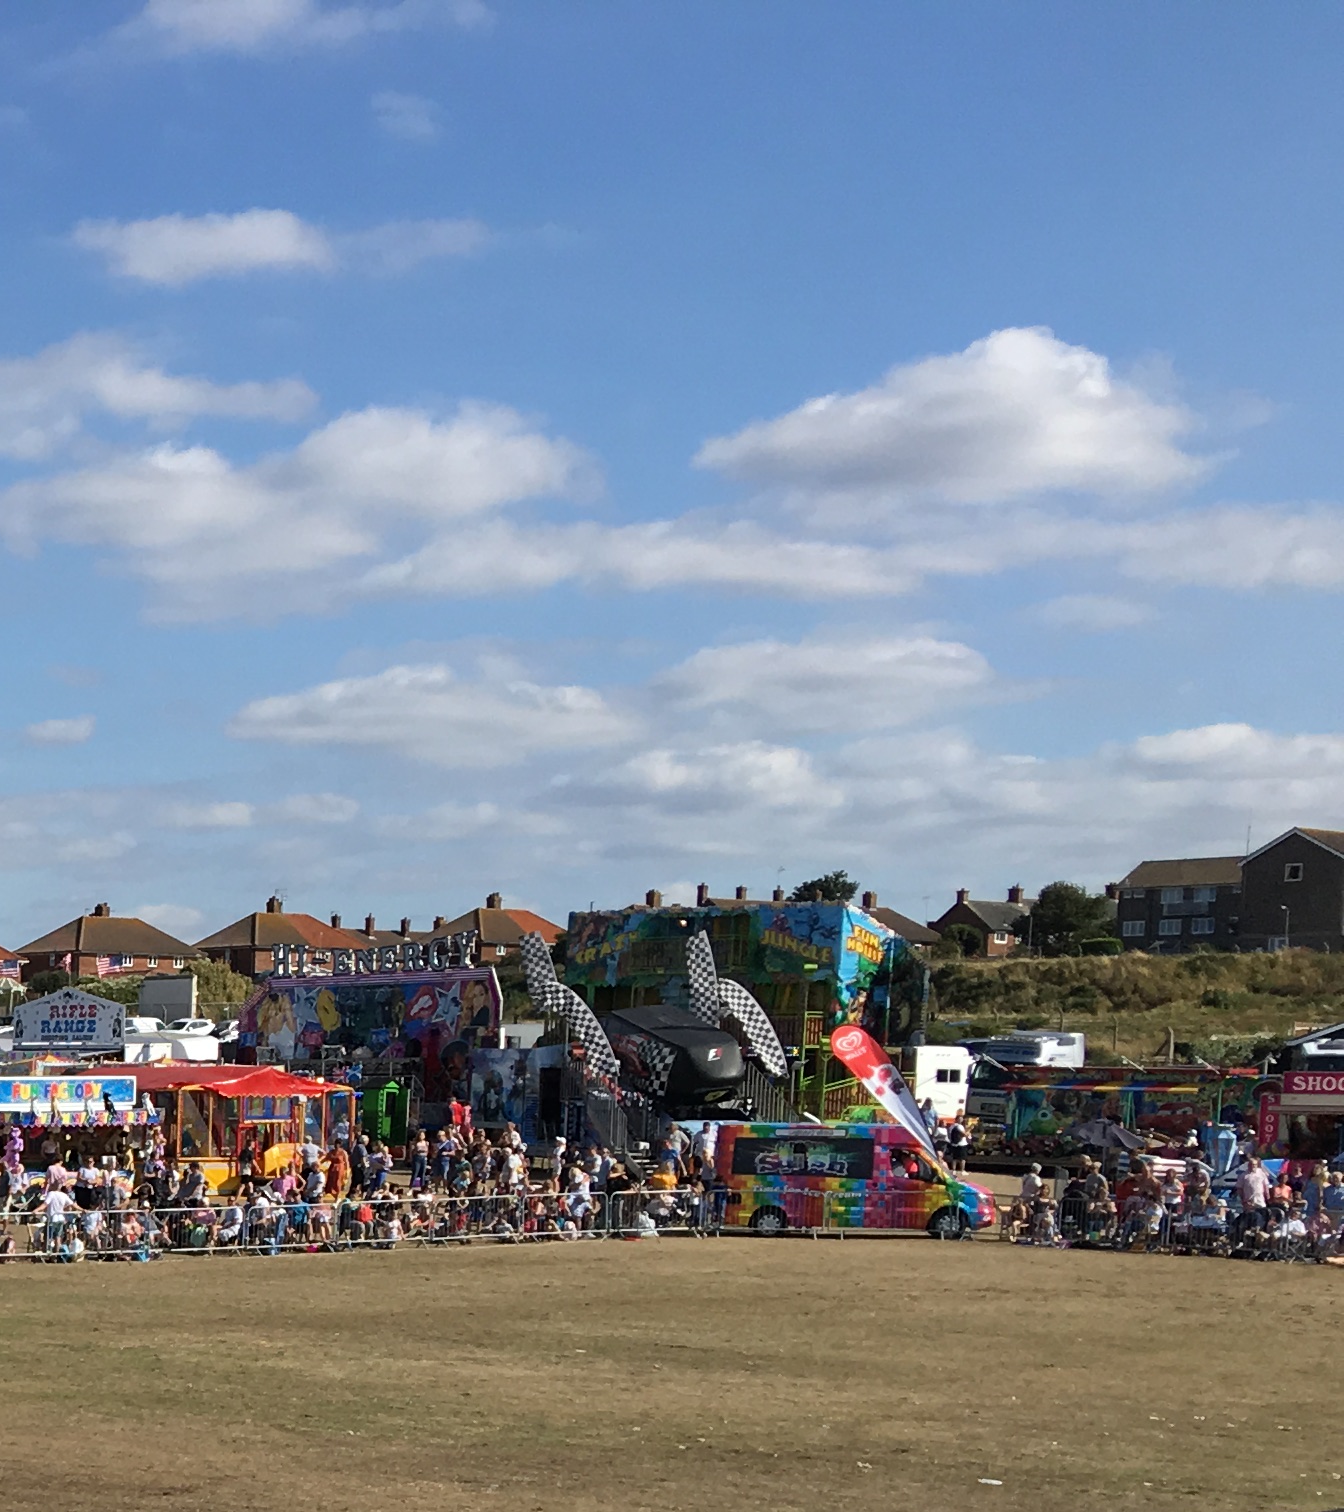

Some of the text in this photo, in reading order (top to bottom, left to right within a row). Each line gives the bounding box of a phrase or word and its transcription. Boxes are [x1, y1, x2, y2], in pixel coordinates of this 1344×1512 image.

[760, 928, 832, 962] JUNGLE
[854, 925, 879, 949] FUN
[270, 930, 479, 978] HI-ENERGY
[50, 1004, 98, 1020] RIFLE
[40, 1019, 97, 1033] RANGE
[13, 1082, 103, 1100] FUN FACTORY
[1264, 1093, 1276, 1143] SOOT
